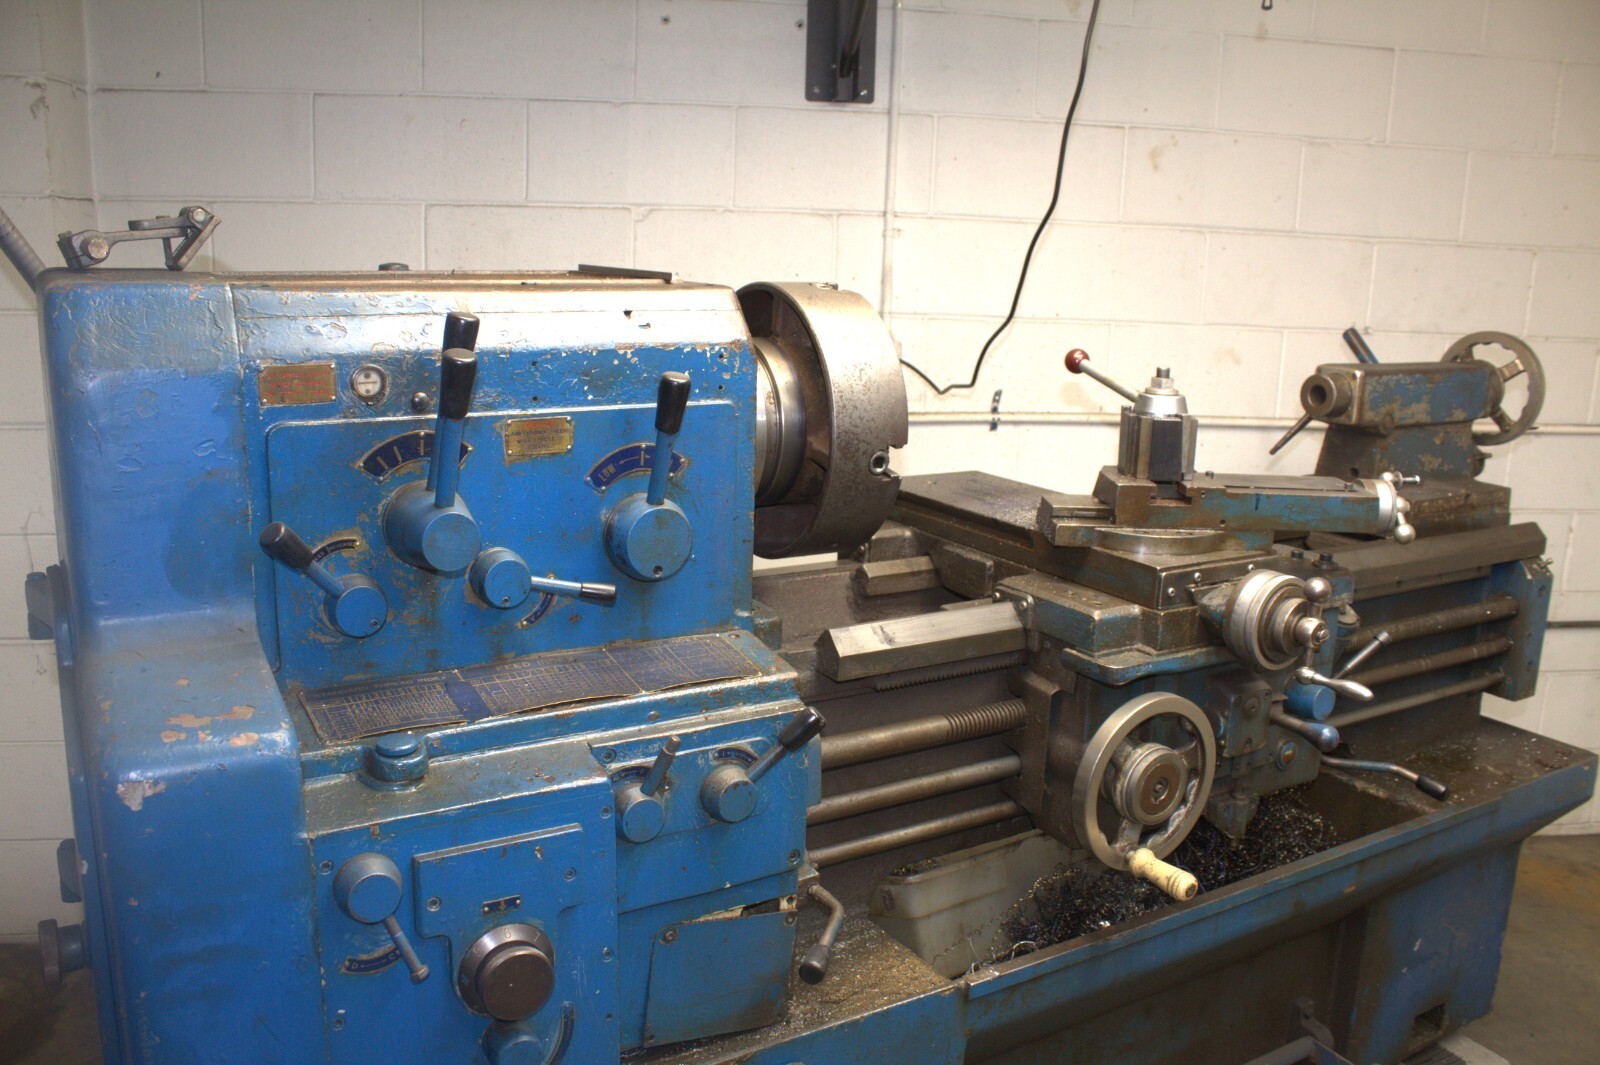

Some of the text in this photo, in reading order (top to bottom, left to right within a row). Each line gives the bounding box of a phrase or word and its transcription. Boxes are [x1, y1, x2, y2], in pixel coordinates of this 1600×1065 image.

[598, 463, 617, 482] LOW
[496, 662, 531, 671] FEED
[503, 927, 512, 939] 6
[533, 931, 542, 943] 7
